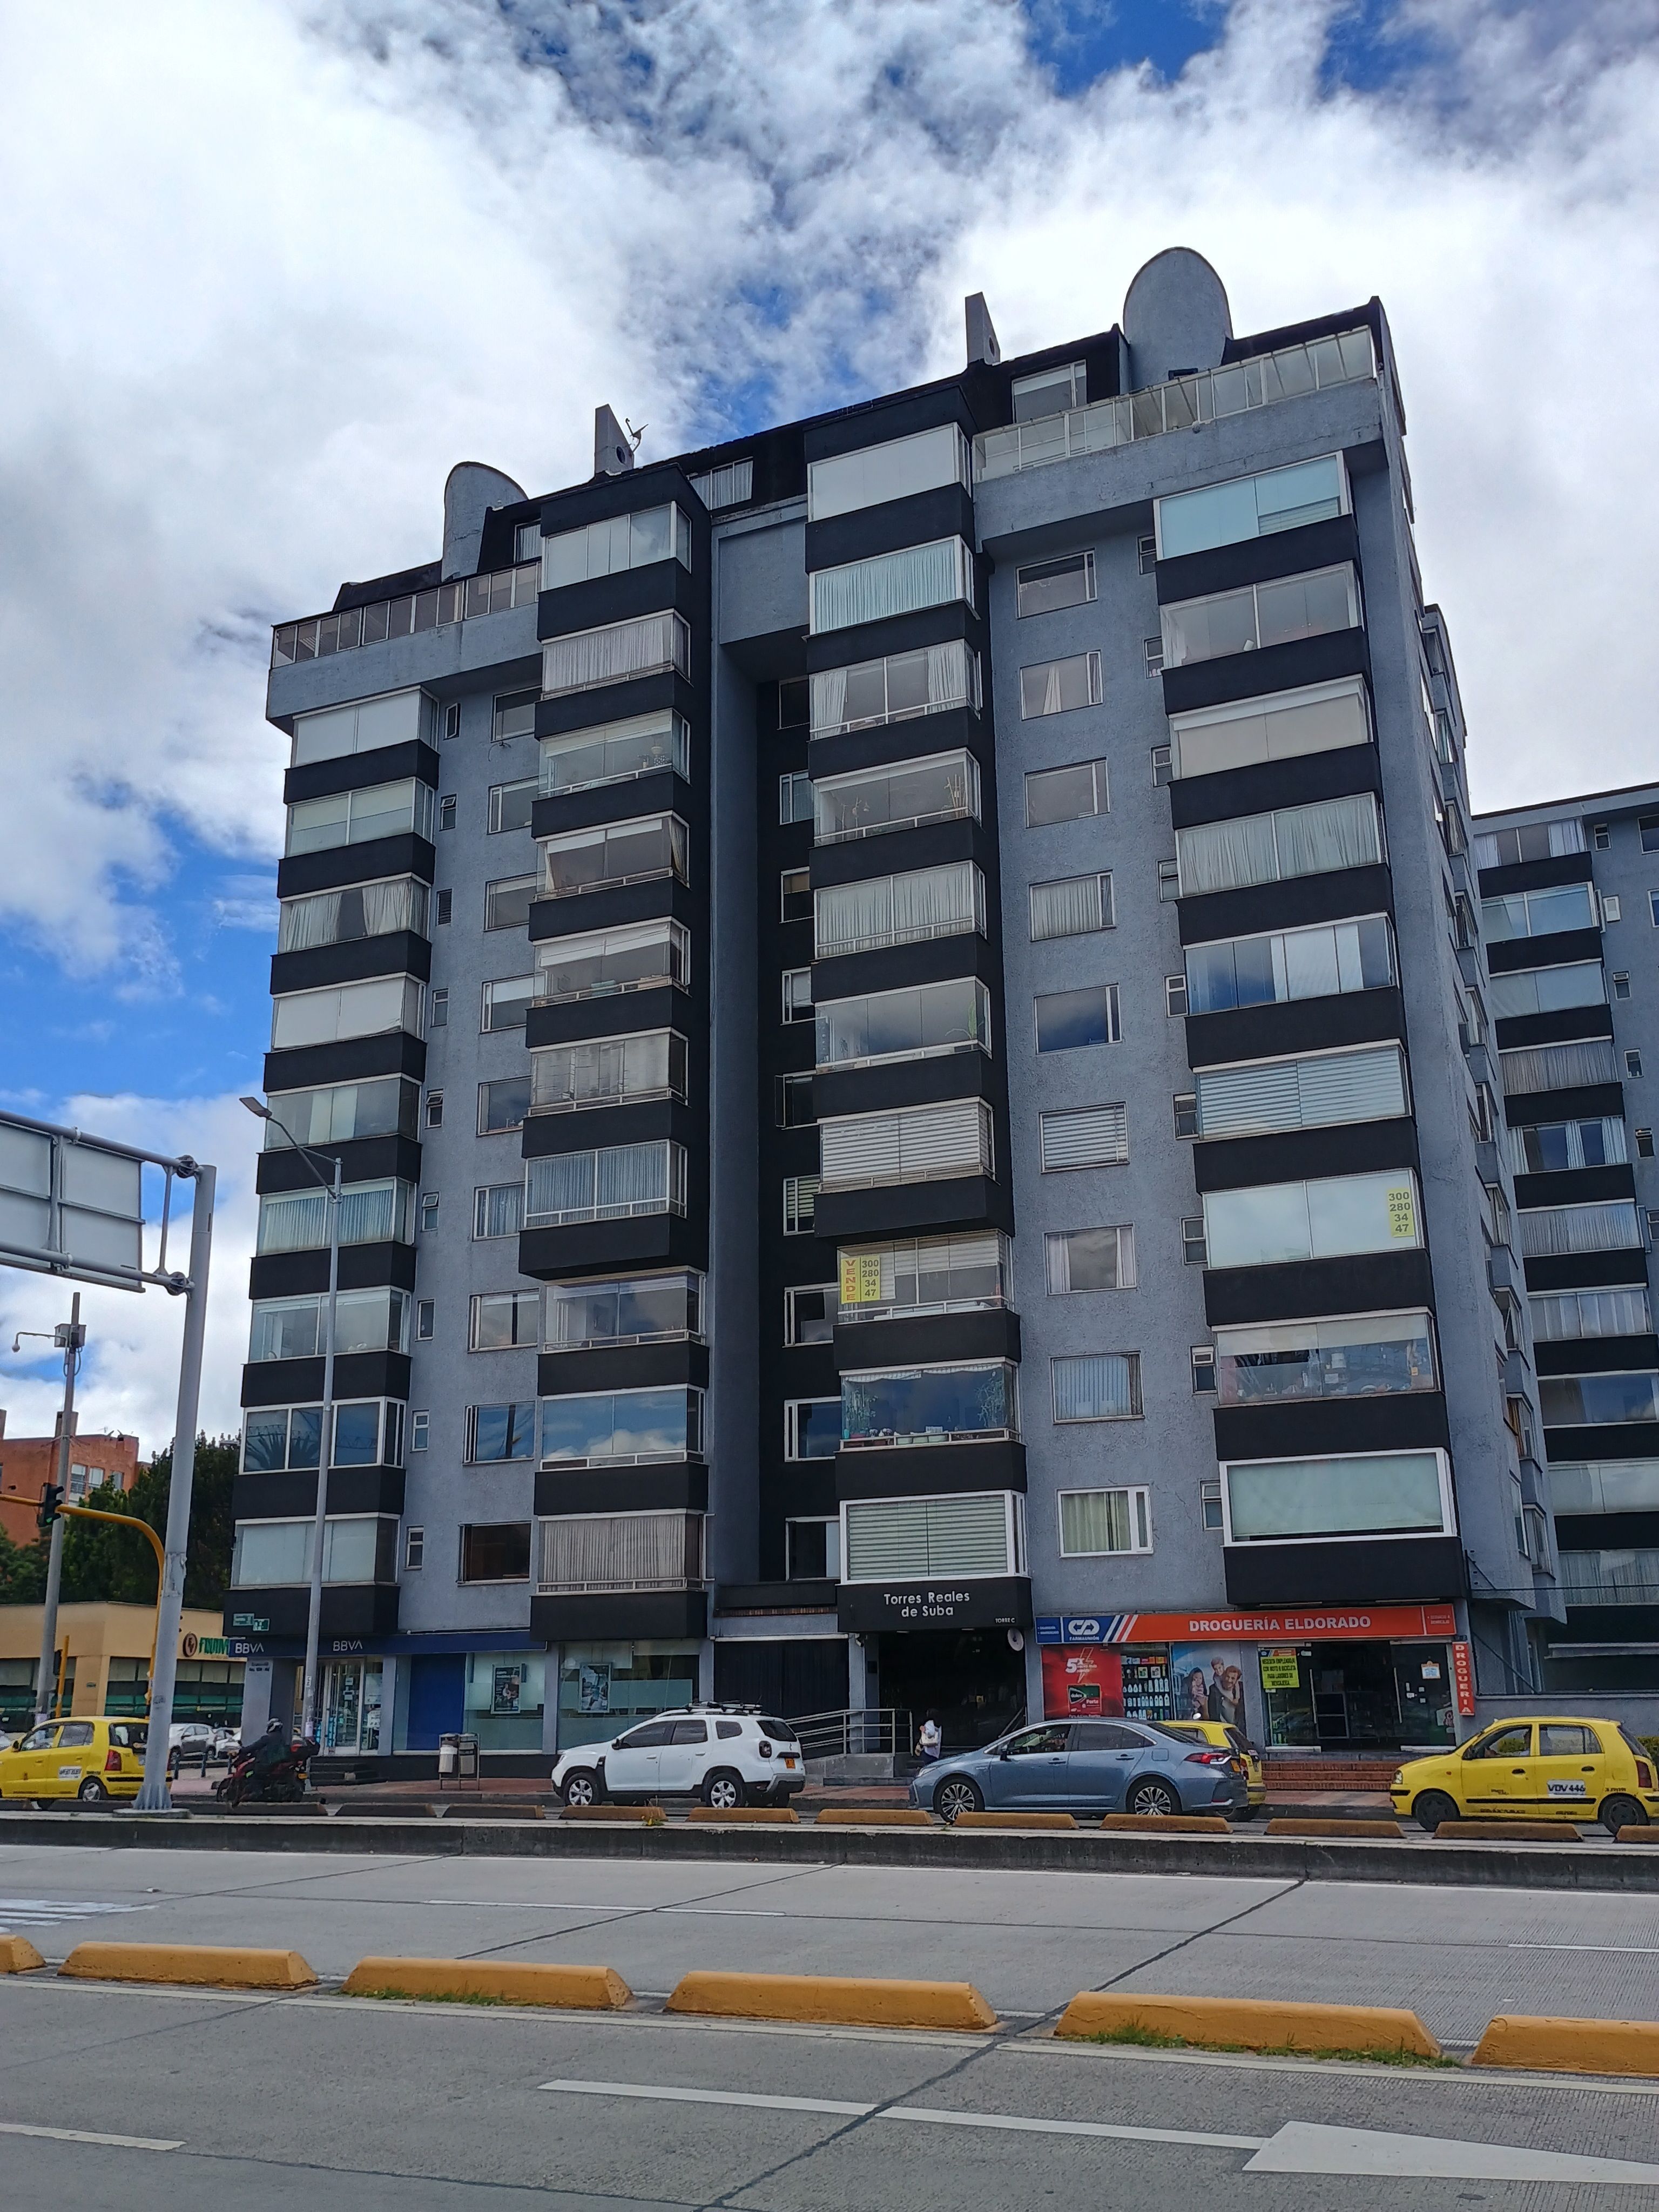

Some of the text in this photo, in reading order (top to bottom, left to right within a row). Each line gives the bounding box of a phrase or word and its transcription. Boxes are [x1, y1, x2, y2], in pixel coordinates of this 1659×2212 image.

[1388, 1191, 1410, 1201] 300
[1389, 1202, 1411, 1212] 280
[1394, 1213, 1408, 1222] 34
[1395, 1224, 1409, 1232] 47
[861, 1259, 879, 1268] 300
[861, 1269, 879, 1278] 280
[845, 1260, 856, 1301] VENDE
[865, 1279, 876, 1287] 34
[865, 1289, 876, 1297] 47
[884, 1591, 970, 1605] Torres Reales
[901, 1604, 954, 1617] de Suba
[1189, 1616, 1371, 1632] DROGUERÍA ELDORADO
[234, 1643, 265, 1654] BBVA
[333, 1639, 363, 1651] BBVA
[1455, 1644, 1472, 1713] DROGUERIA
[1547, 1784, 1568, 1792] VDV
